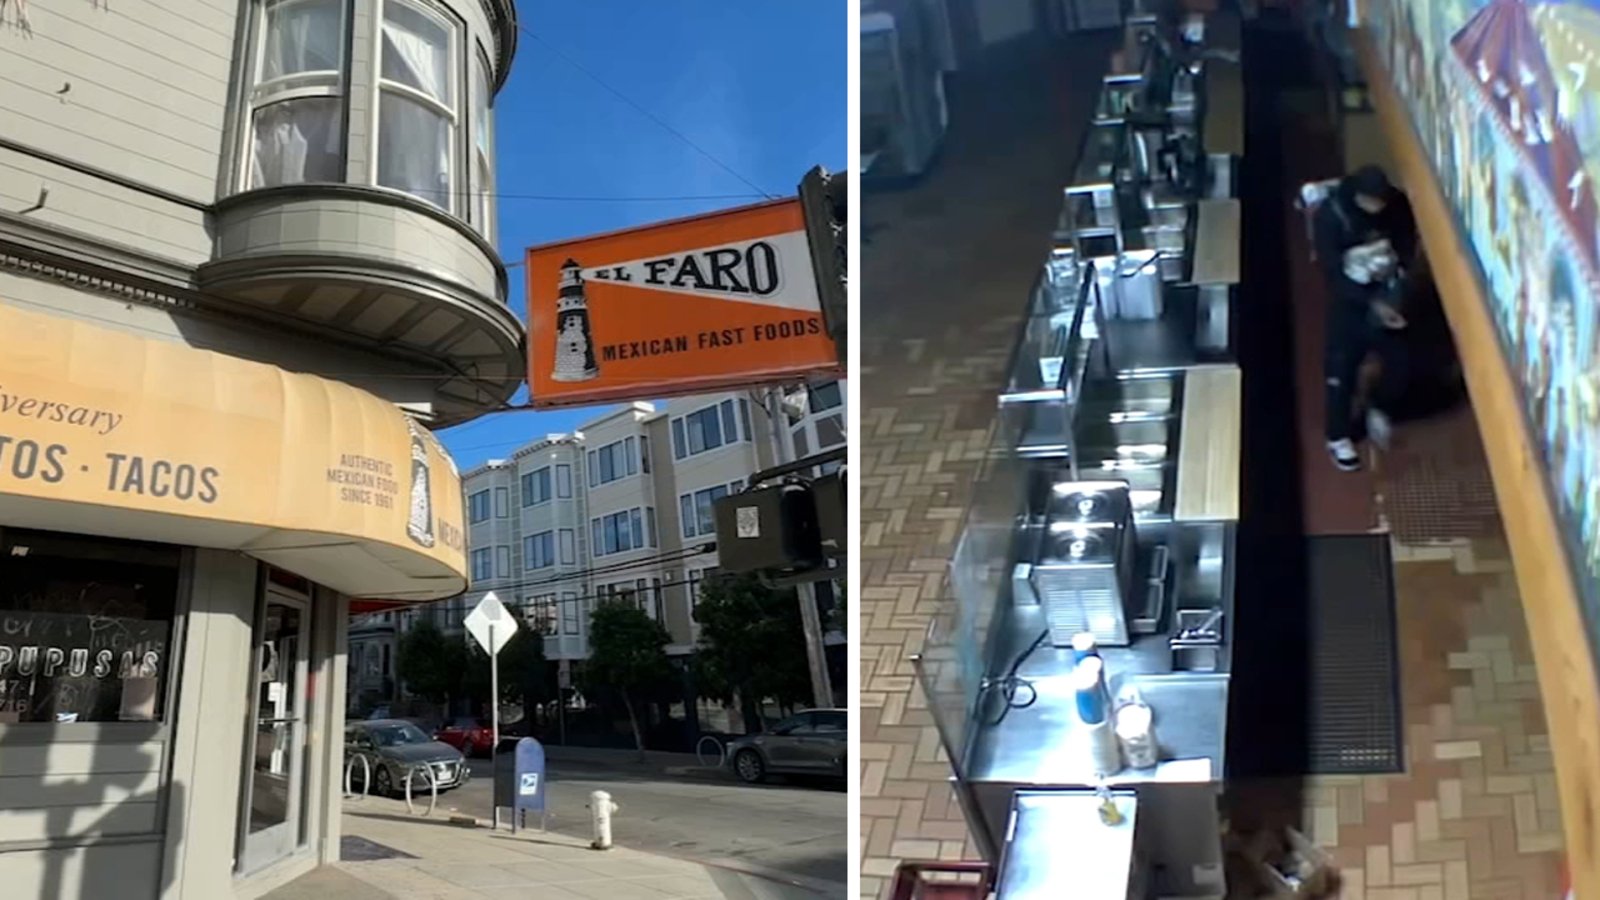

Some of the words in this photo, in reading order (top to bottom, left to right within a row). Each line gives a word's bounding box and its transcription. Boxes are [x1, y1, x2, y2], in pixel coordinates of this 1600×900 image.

[594, 266, 632, 282] EL
[644, 241, 778, 295] FARO
[602, 335, 688, 361] MEXICAN
[698, 328, 744, 349] FAST
[754, 317, 820, 341] FOODS
[106, 452, 219, 504] TACOS
[326, 468, 375, 487] MEXICAN
[377, 476, 398, 495] FOOD
[341, 453, 392, 477] AUTHENTIC
[340, 487, 373, 505] SINCE
[375, 493, 393, 510] 1961
